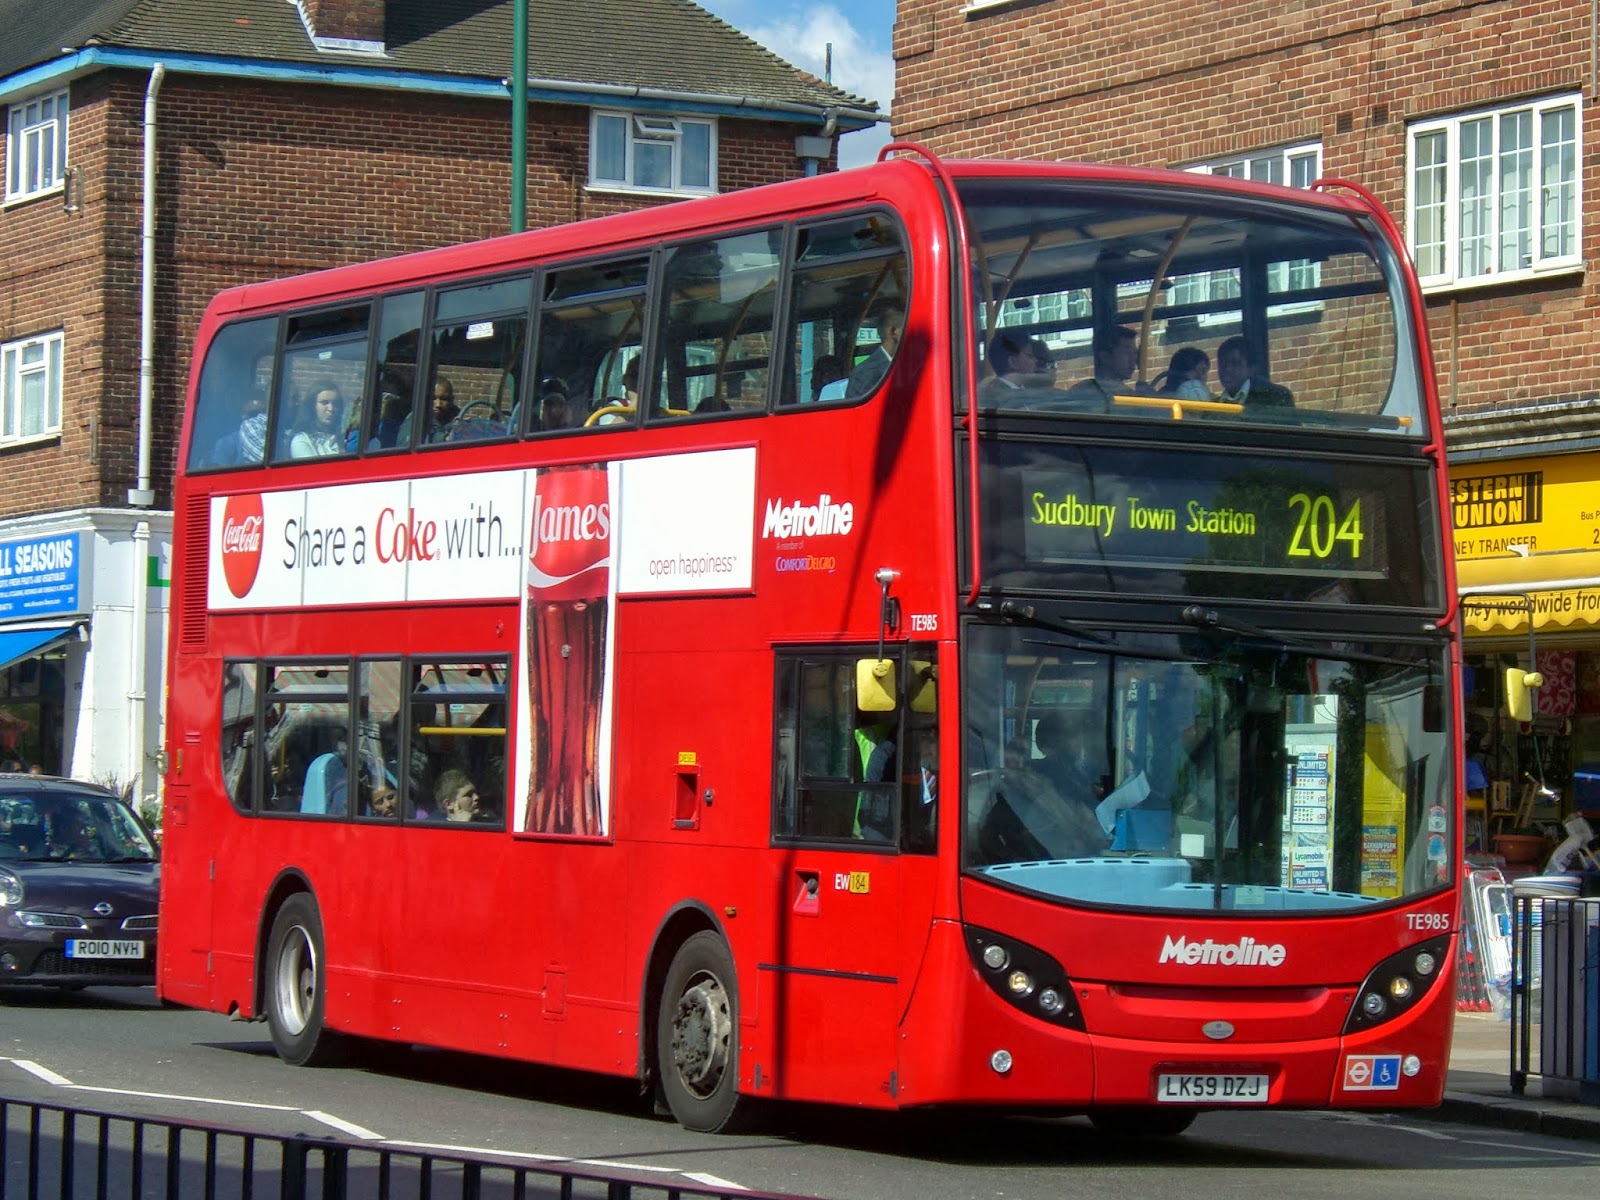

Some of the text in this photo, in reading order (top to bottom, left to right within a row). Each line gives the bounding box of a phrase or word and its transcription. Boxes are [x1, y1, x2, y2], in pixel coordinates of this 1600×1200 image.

[529, 495, 610, 558] James
[762, 494, 853, 539] Metroline
[1031, 492, 1255, 537] Sudbury Town Station
[1288, 493, 1363, 558] 204
[1455, 501, 1522, 527] UNION
[1580, 511, 1594, 520] Bus
[283, 500, 522, 569] Share a Coke with...
[15, 539, 73, 574] SEASONS
[649, 559, 676, 580] open
[910, 614, 938, 631] TE985
[835, 873, 866, 890] EW 184
[1406, 913, 1450, 931] TE985
[112, 942, 139, 955] NVH
[1158, 934, 1287, 967] Metroline
[1165, 1077, 1261, 1096] LK59 DZJ
